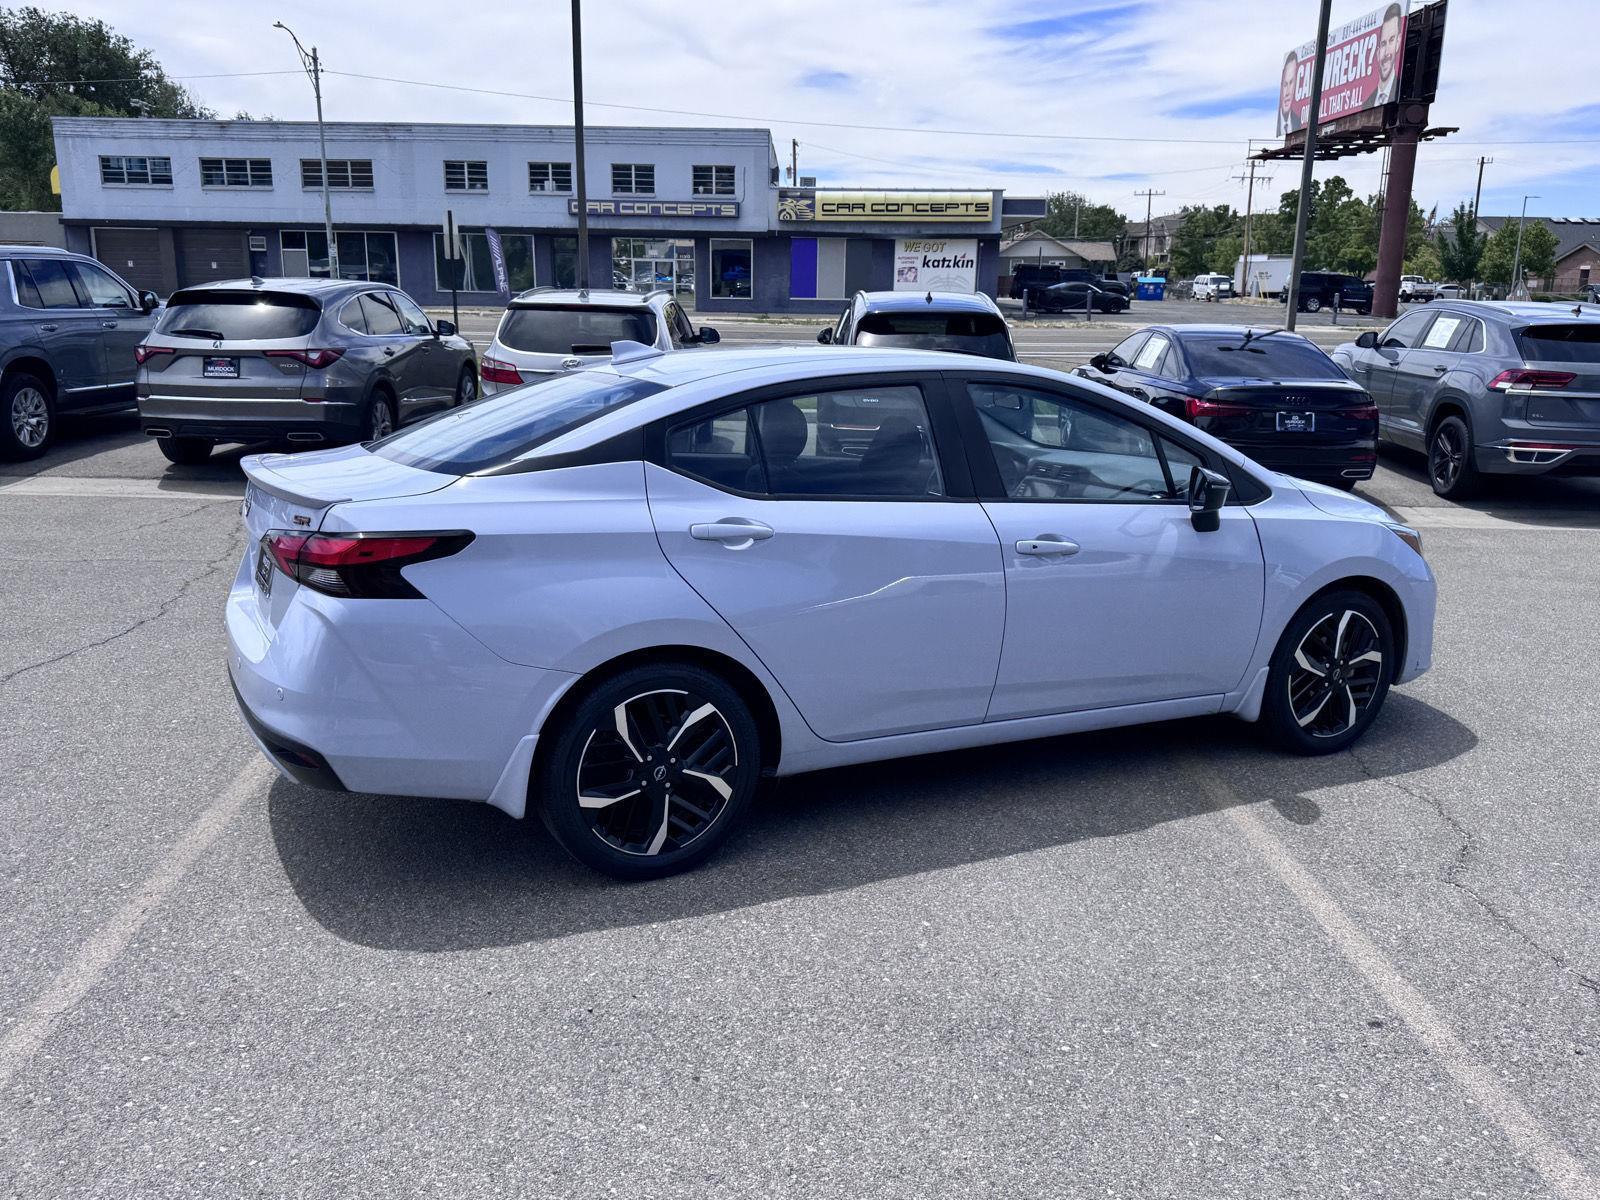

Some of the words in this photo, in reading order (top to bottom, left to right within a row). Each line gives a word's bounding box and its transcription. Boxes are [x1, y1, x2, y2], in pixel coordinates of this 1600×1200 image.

[1321, 33, 1378, 92] WRECK?
[1300, 104, 1311, 124] ON
[1329, 89, 1351, 116] THAT'S
[1350, 86, 1363, 109] ALL
[619, 203, 736, 216] CONCEPTS
[821, 202, 866, 213] CAR
[870, 202, 990, 213] CONCEPTS
[904, 241, 921, 253] WE
[922, 241, 947, 253] GOT
[922, 253, 974, 269] katzkin
[493, 252, 509, 293] ALPINE
[294, 515, 311, 527] SR
